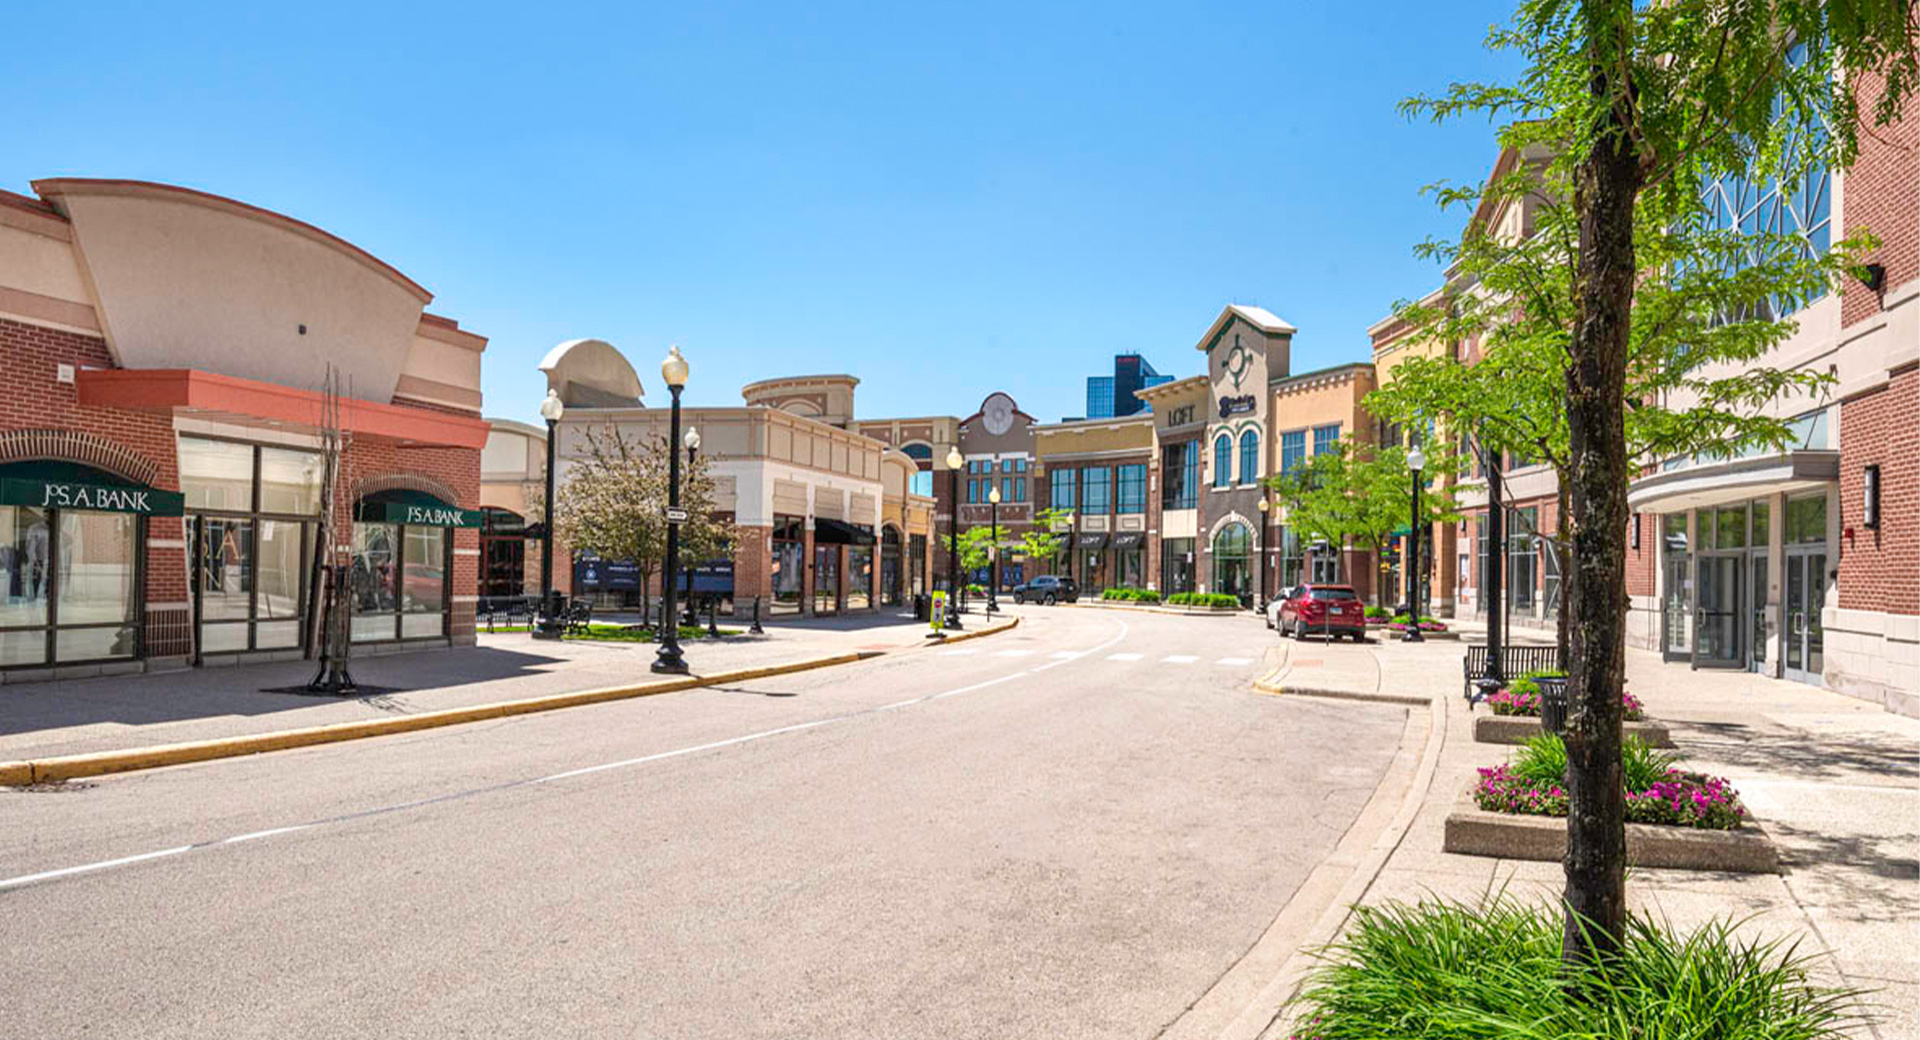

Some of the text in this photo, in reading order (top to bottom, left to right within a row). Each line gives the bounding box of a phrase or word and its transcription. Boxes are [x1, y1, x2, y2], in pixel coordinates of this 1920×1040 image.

[1168, 404, 1195, 427] LOFT
[96, 488, 151, 511] BANK
[434, 509, 464, 525] BANK
